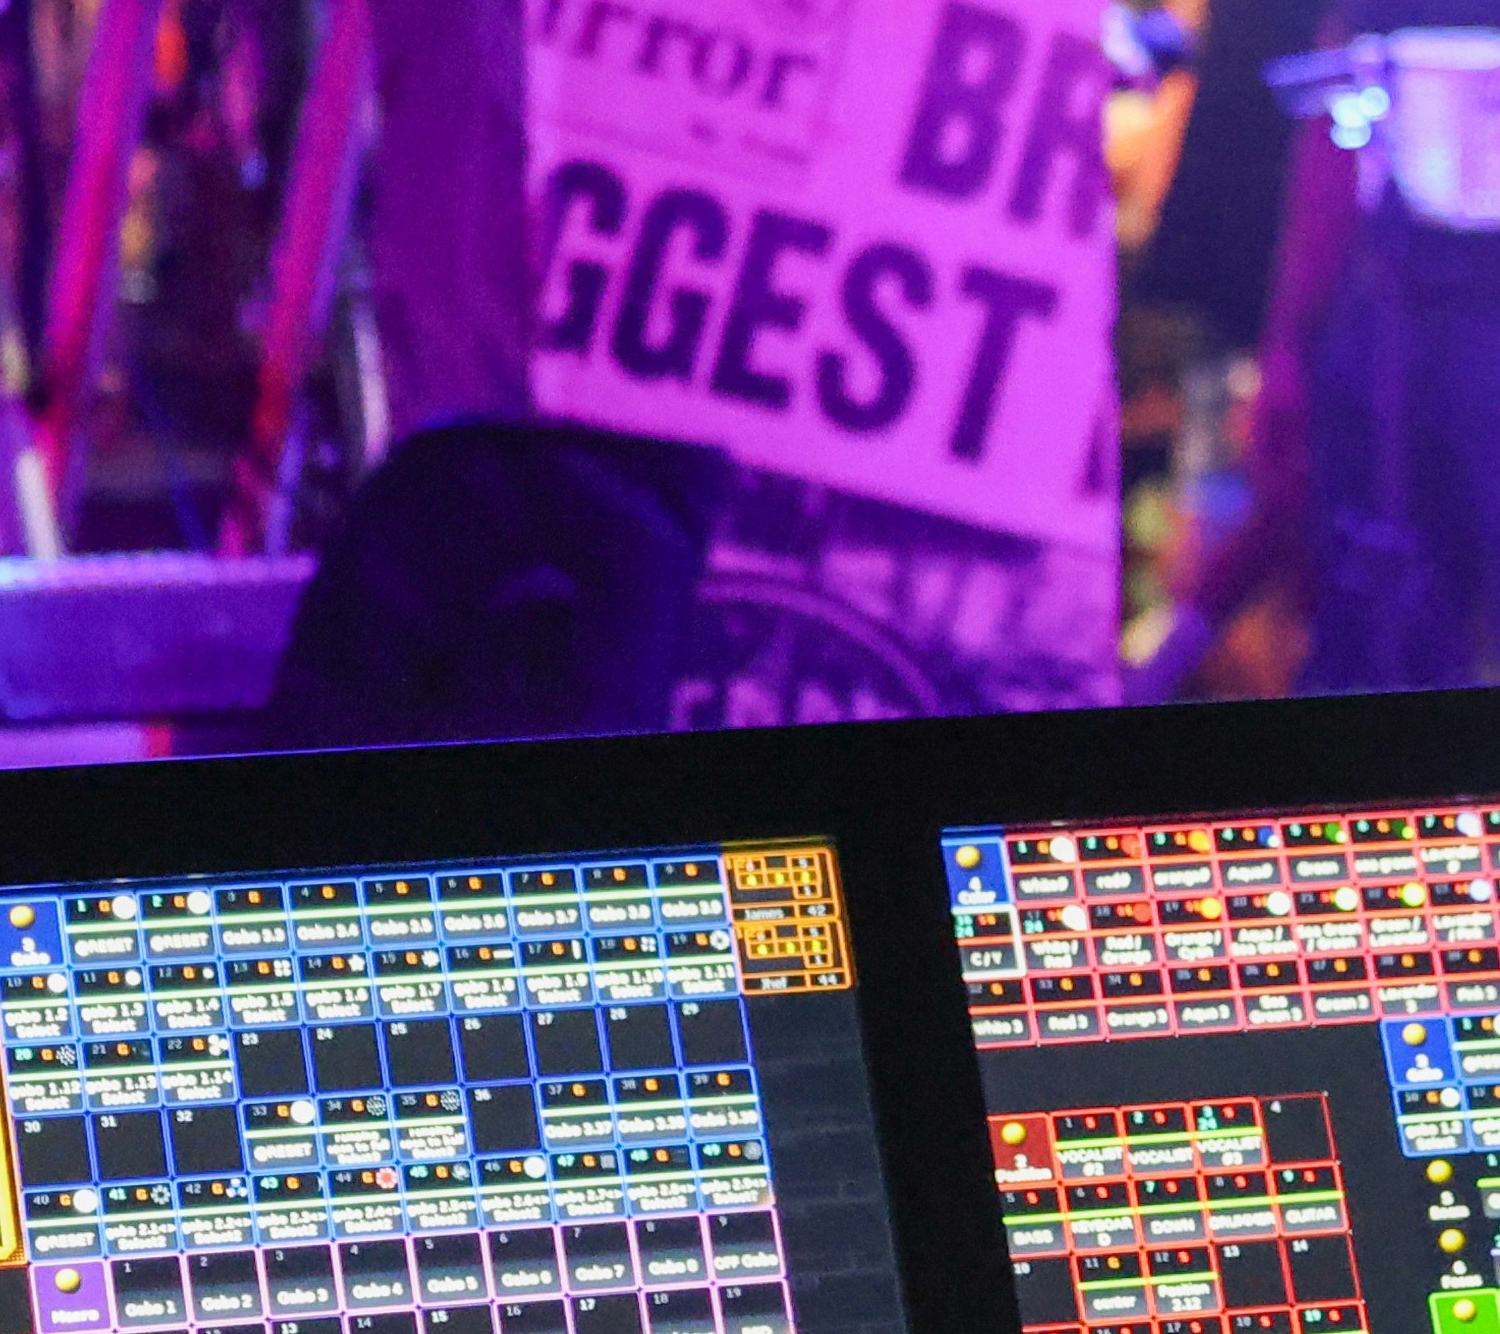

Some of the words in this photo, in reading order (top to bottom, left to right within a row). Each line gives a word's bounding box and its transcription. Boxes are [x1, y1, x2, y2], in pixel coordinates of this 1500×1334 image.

[100, 1115, 118, 1128] 31
[175, 1109, 194, 1122] 32
[24, 1120, 41, 1133] 30
[1199, 1136, 1262, 1153] VOCALIST
[995, 1167, 1052, 1183] Position
[1208, 1211, 1275, 1230] DRUMMER
[1285, 1206, 1337, 1223] GUITAR
[1150, 1219, 1196, 1234] DOWN
[1013, 1229, 1053, 1245] BASS
